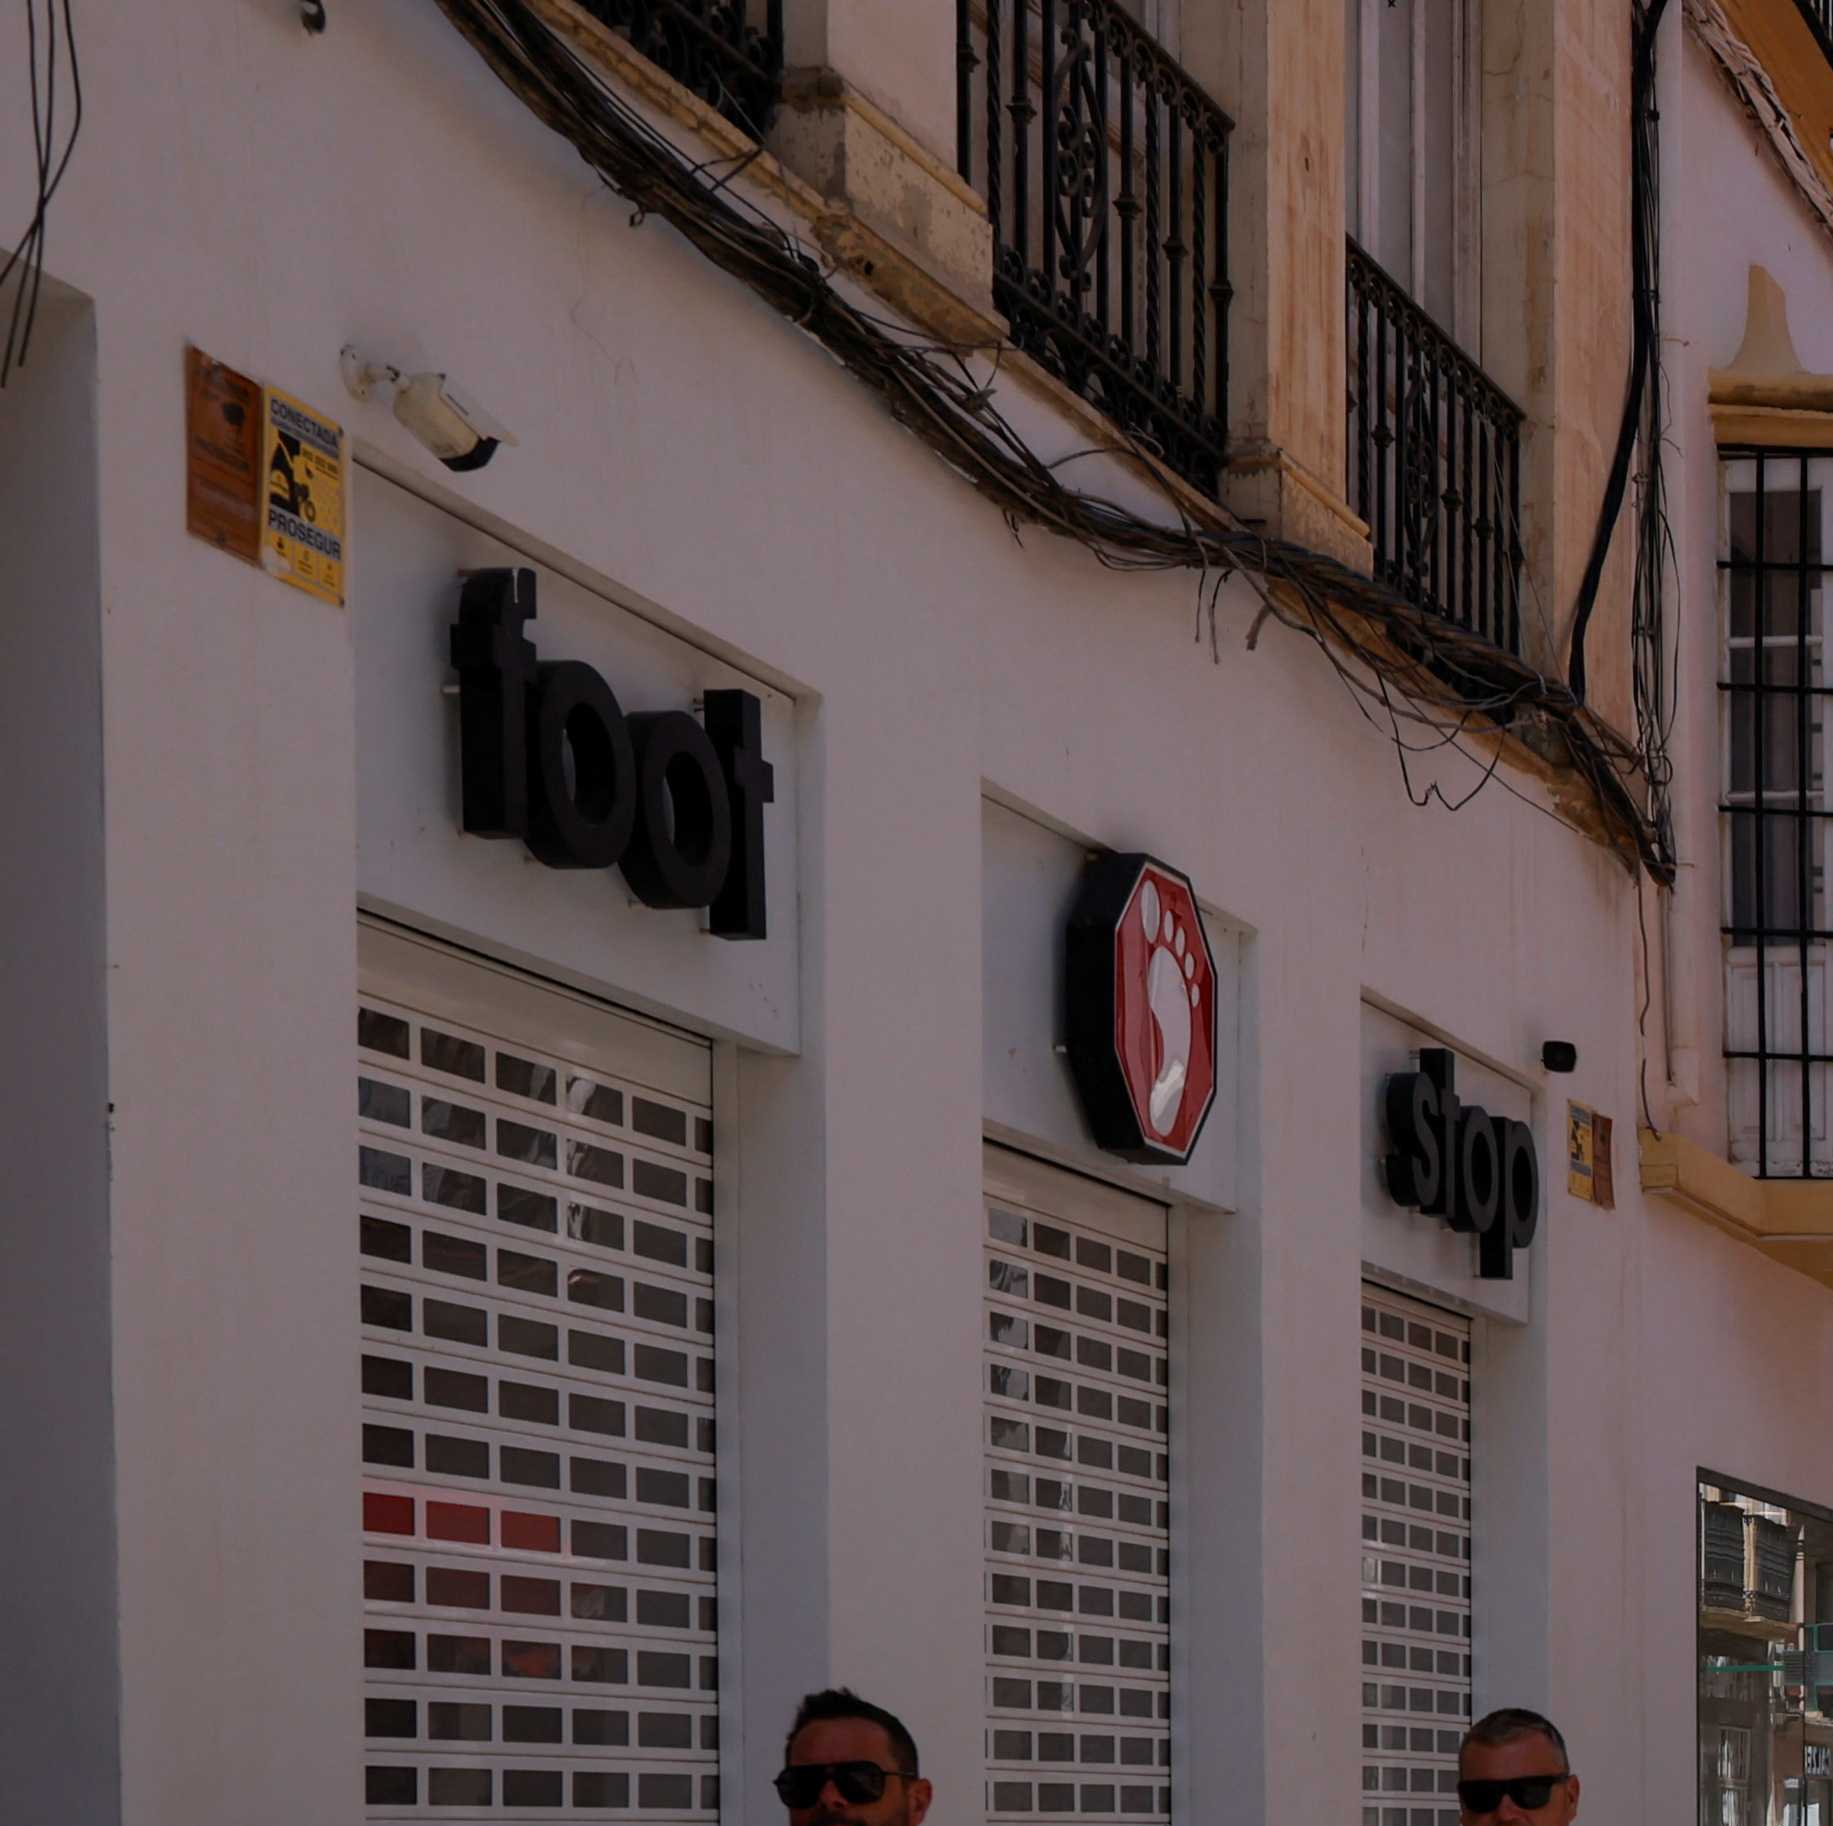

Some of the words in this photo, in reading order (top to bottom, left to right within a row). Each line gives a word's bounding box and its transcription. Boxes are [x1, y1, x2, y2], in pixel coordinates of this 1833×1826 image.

[270, 398, 338, 449] CONECTADA
[268, 509, 341, 560] PROSEGUR
[451, 568, 775, 940] foot
[1385, 1047, 1539, 1280] stop
